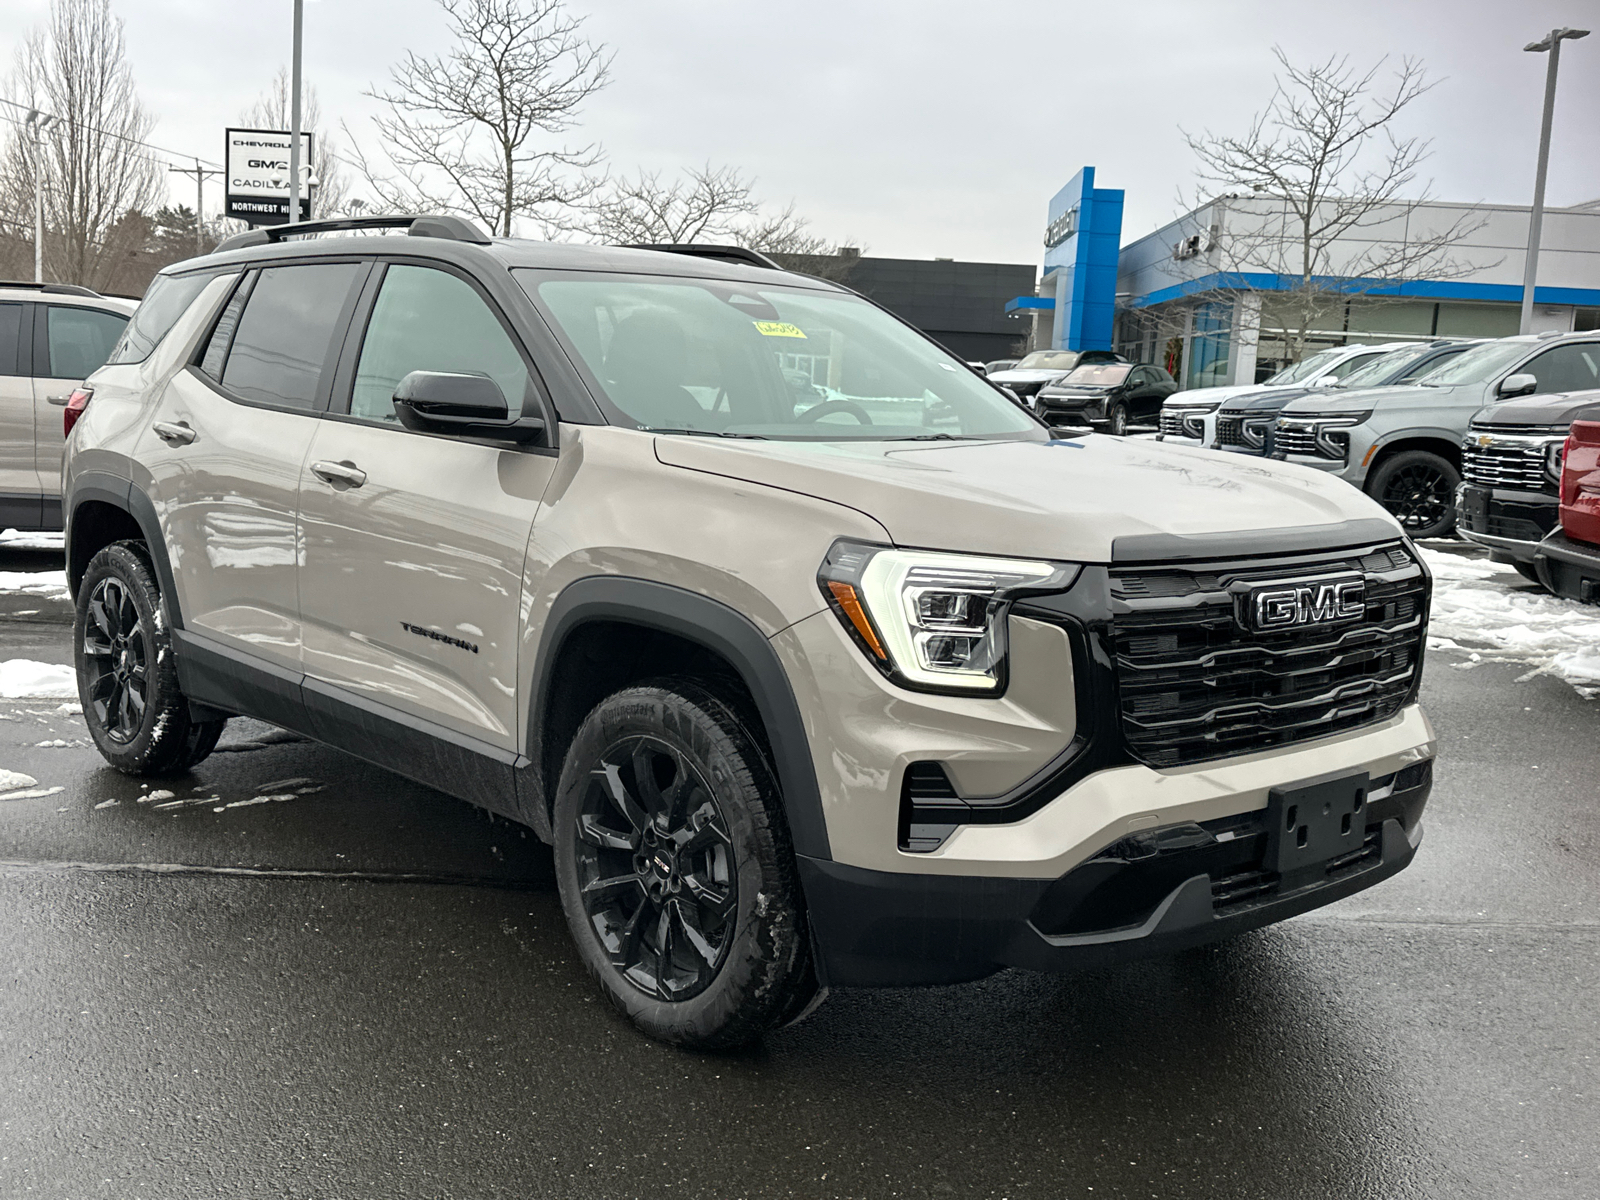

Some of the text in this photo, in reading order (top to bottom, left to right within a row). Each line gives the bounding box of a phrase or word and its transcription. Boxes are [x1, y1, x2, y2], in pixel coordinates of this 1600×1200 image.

[233, 140, 303, 149] CHEVROL
[248, 159, 288, 170] GMC
[231, 202, 303, 214] NORTHWEST HIS
[1257, 580, 1365, 628] GMC
[400, 621, 479, 654] TERRAIN
